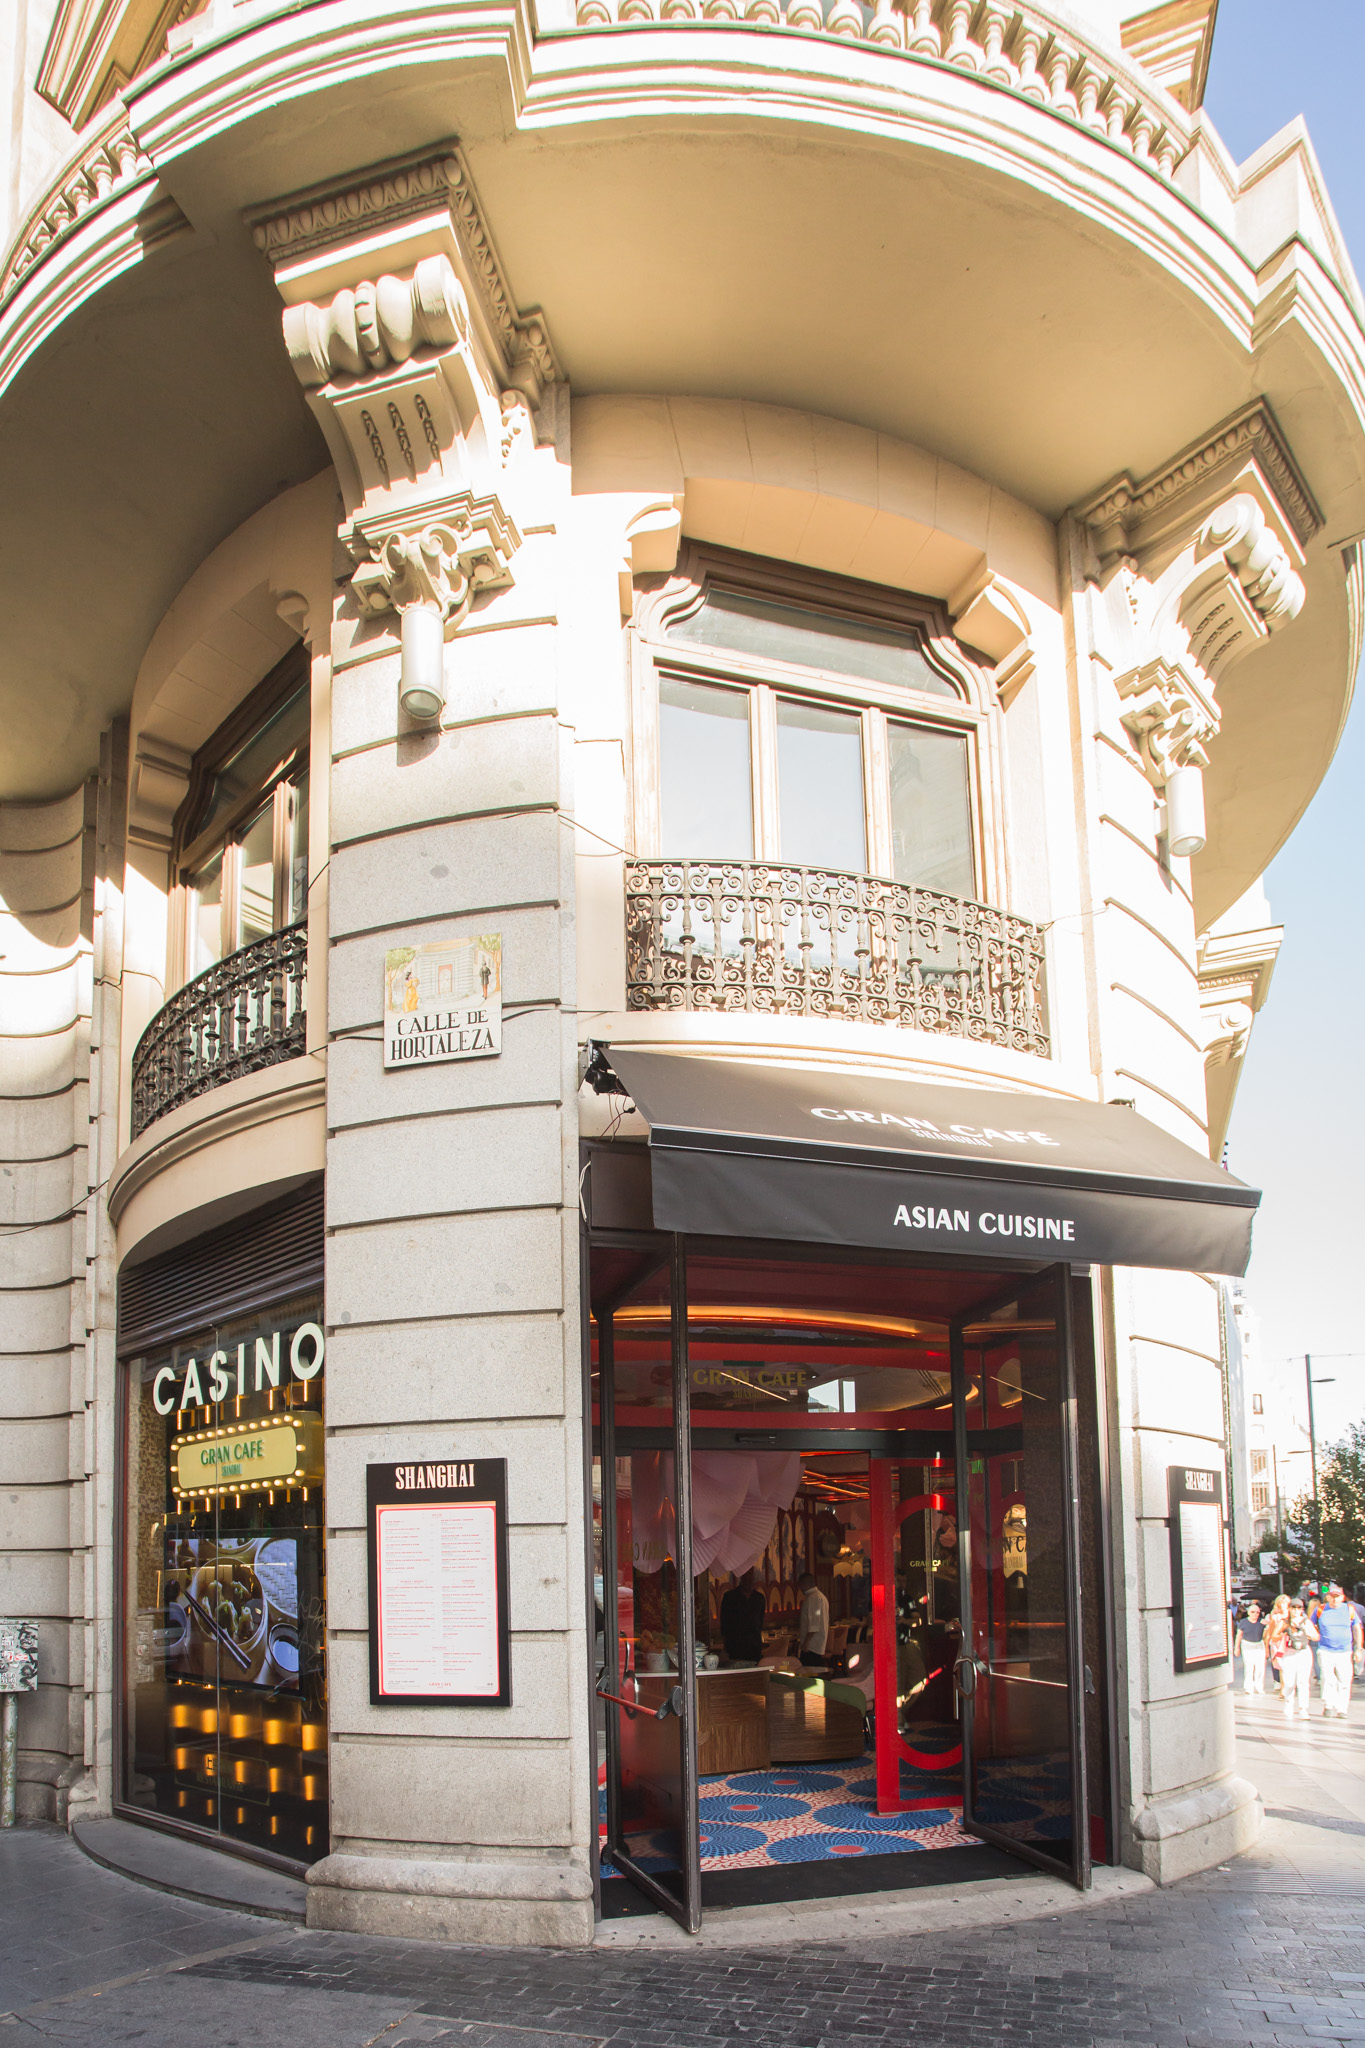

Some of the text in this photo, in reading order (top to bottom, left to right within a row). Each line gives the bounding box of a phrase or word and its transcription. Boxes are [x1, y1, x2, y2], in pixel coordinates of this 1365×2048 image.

[397, 1010, 489, 1036] CALLE DE
[390, 1028, 495, 1061] HORTALEZA
[810, 1107, 940, 1133] GRAN
[909, 1128, 994, 1148] SHANGHAI
[893, 1204, 1076, 1242] ASIAN CUISINE
[153, 1322, 325, 1416] CASINO
[693, 1369, 750, 1386] GRAN
[201, 1445, 231, 1466] GRAN
[395, 1463, 475, 1490] SHANGHAI
